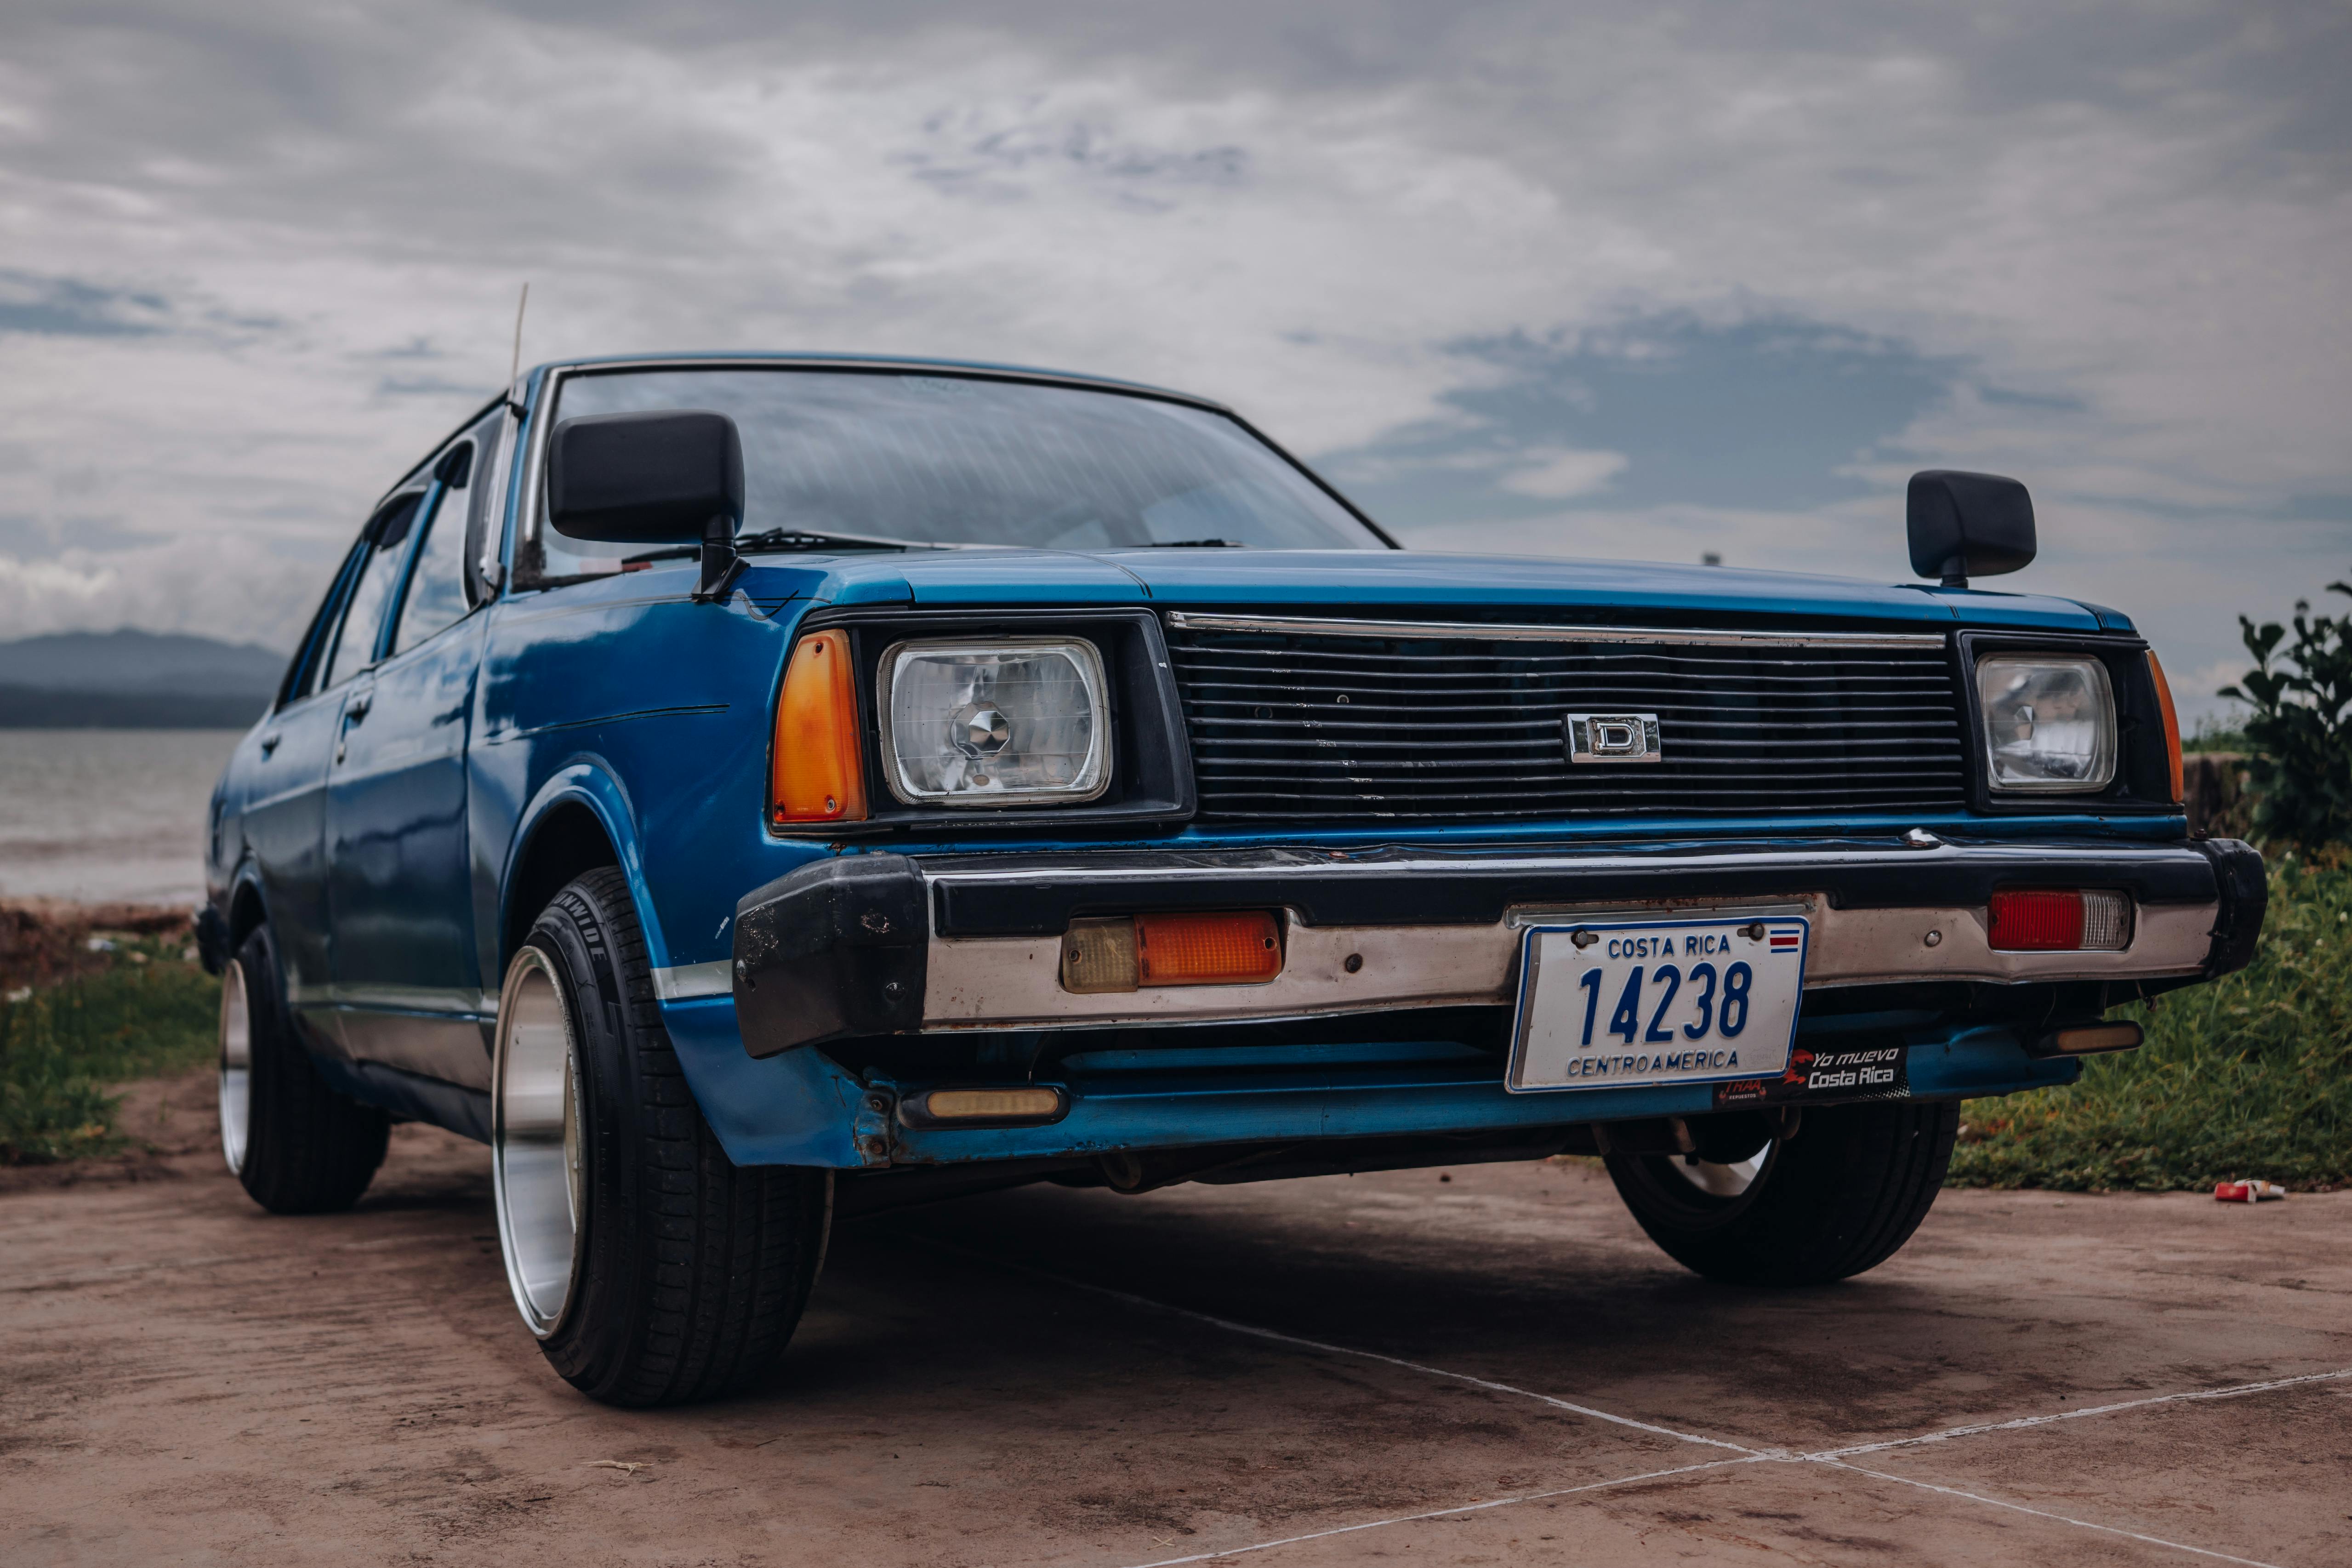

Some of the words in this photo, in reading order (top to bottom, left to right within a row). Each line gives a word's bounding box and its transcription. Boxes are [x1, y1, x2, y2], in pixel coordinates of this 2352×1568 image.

[1597, 723, 1634, 750] D
[1608, 935, 1674, 959] COSTA
[1685, 934, 1731, 956] RICA
[1579, 961, 1753, 1047] 14238
[1567, 1049, 1738, 1077] CENTROAMERICA
[1812, 1052, 1834, 1068] Yo
[1836, 1048, 1899, 1065] muevo
[1808, 1070, 1856, 1089] Costa
[1859, 1066, 1894, 1085] Rica
